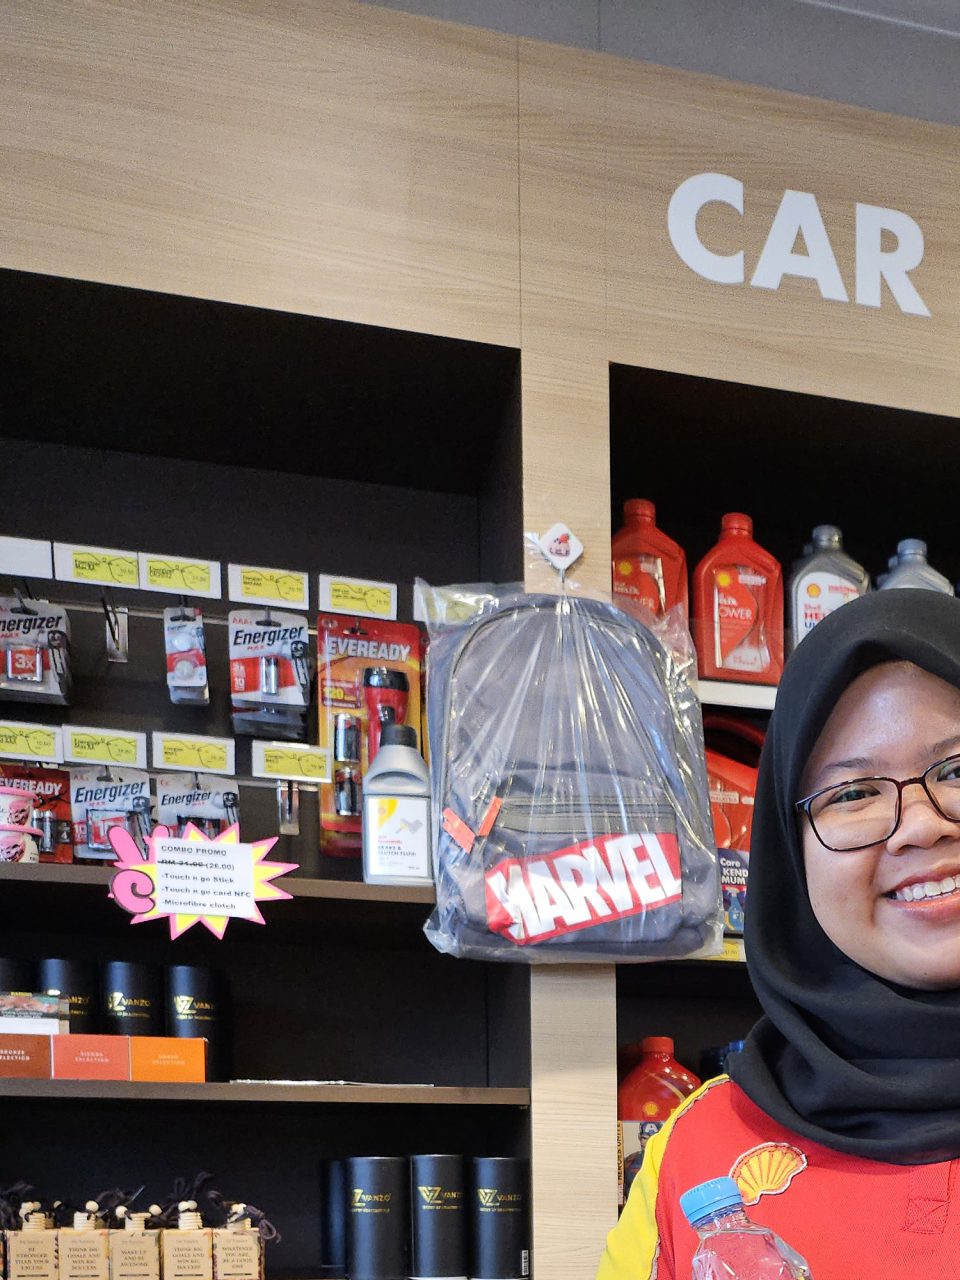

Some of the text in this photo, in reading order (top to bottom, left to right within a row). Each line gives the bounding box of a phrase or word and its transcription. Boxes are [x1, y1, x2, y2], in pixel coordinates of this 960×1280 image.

[667, 172, 932, 318] CAR
[233, 626, 304, 646] Energizer
[328, 637, 411, 661] EVEREADY
[75, 781, 146, 803] Energizer
[161, 791, 212, 807] Energizer
[161, 845, 227, 855] COMBO PROMO
[720, 858, 741, 868] Care
[486, 832, 683, 937] MARVEL
